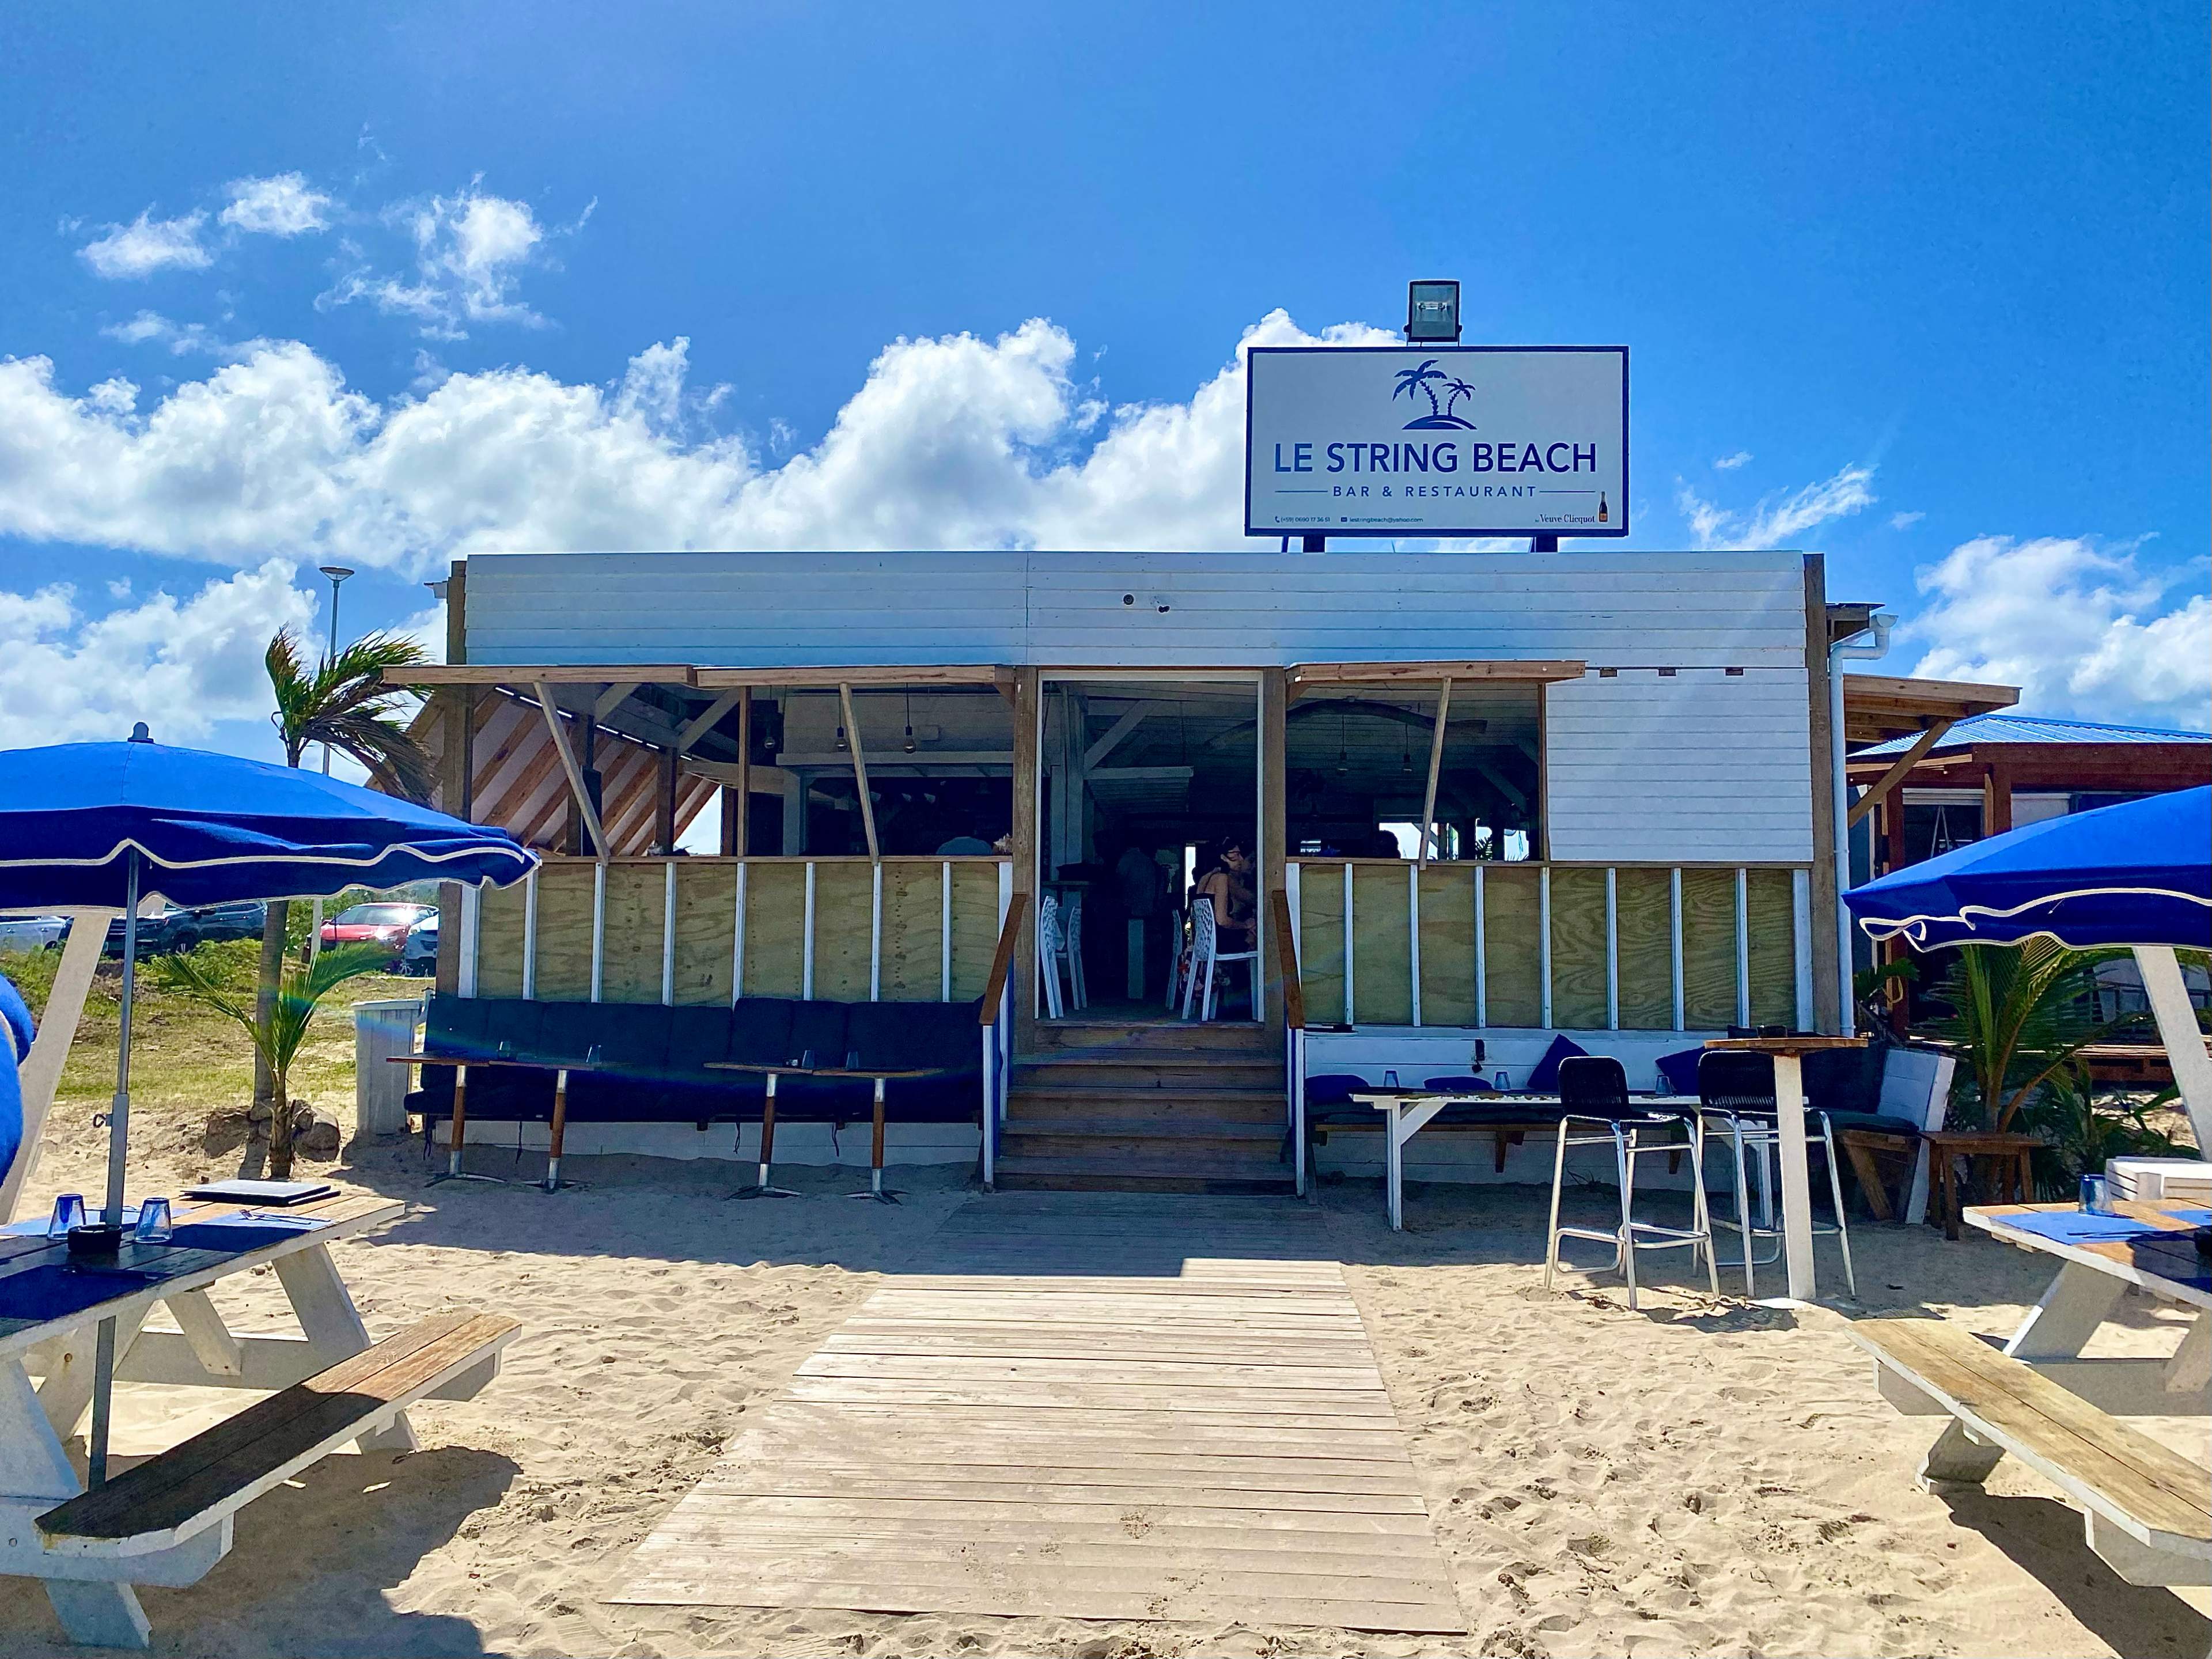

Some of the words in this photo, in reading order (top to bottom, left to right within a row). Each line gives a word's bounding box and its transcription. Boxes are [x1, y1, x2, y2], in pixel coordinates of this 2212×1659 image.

[1275, 443, 1313, 472] LE
[1327, 442, 1458, 473] STRING
[1473, 442, 1596, 472] BEACH
[1333, 486, 1370, 497] BAR
[1382, 486, 1392, 497] &
[1405, 486, 1536, 497] RESTAURANT
[1540, 514, 1562, 522] Veuve
[1563, 514, 1595, 524] Clicquot
